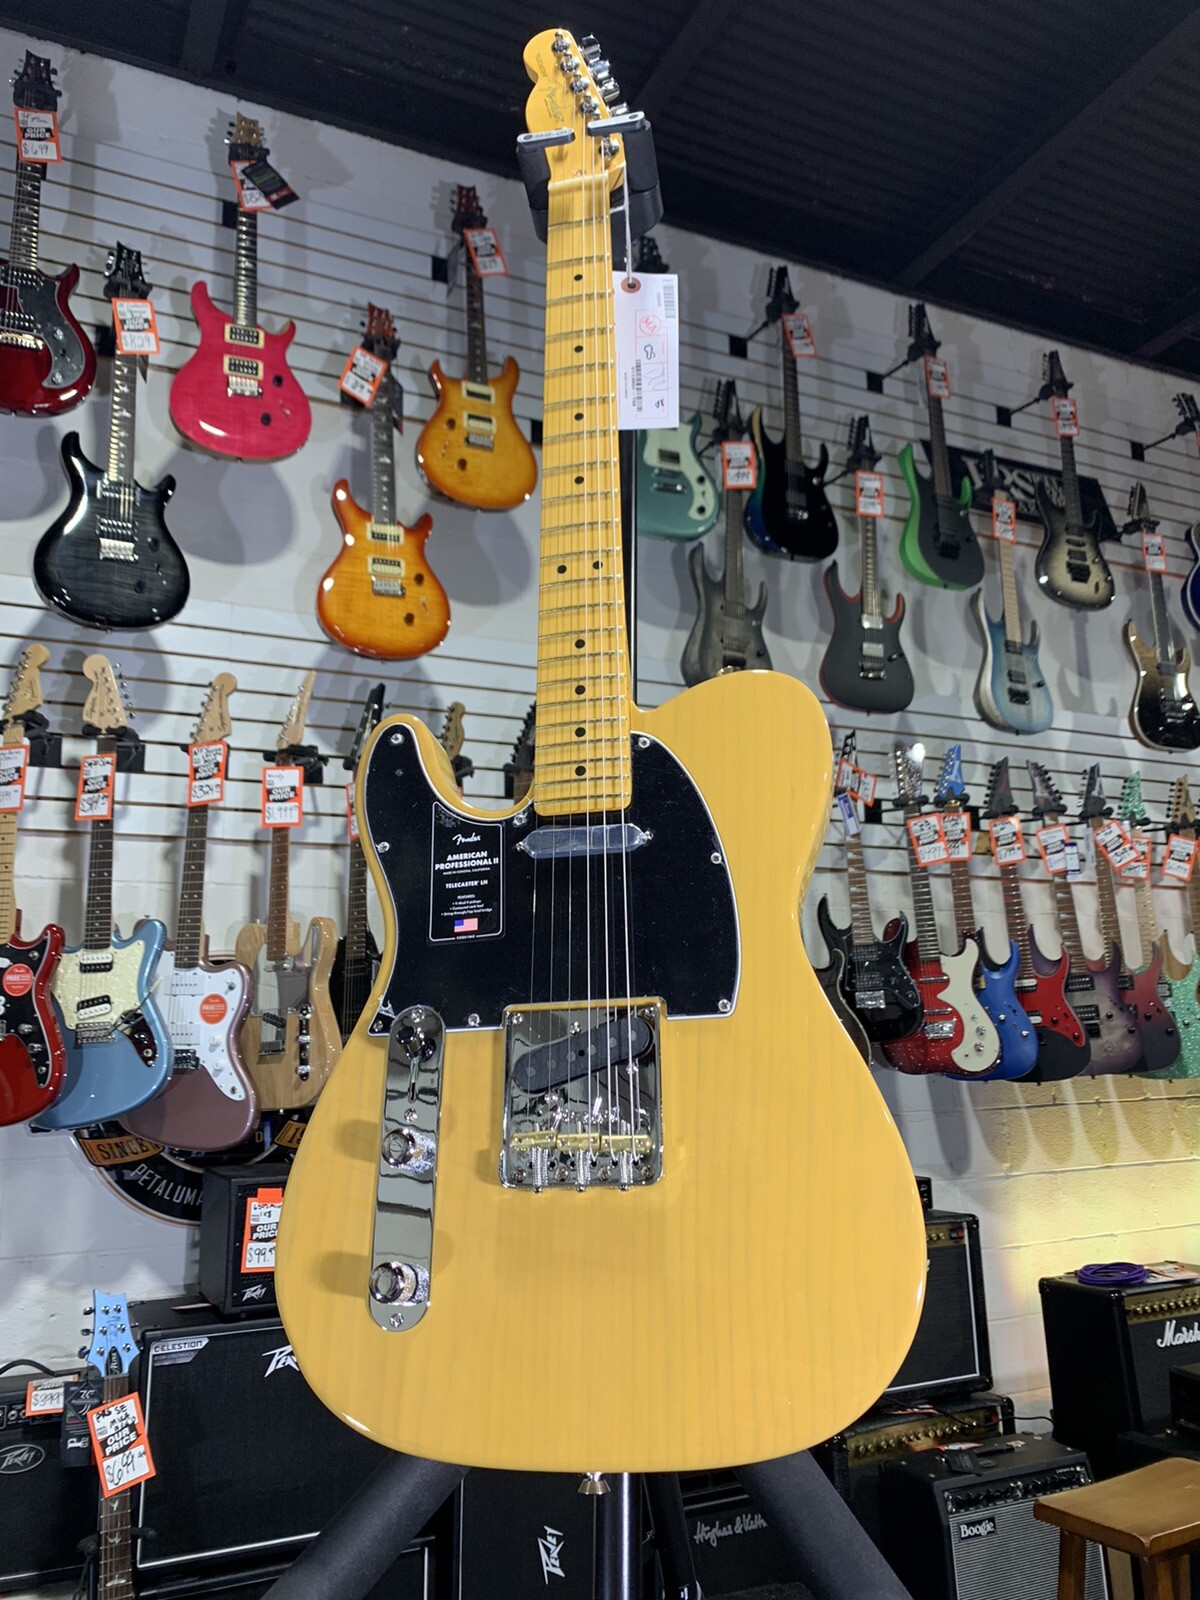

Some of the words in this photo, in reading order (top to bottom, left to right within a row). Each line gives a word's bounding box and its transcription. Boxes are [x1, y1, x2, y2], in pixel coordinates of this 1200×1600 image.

[452, 832, 481, 845] Fender
[435, 858, 493, 871] PROFESSIONAL
[446, 851, 488, 862] AMERICAN
[96, 1138, 149, 1160] SINCE
[256, 1223, 278, 1233] OUR
[153, 1341, 203, 1353] CELESTION
[114, 1404, 128, 1415] SE
[105, 1431, 138, 1456] PRICE
[106, 1426, 131, 1446] OUR
[693, 1520, 733, 1548] Hughes
[734, 1516, 743, 1534] &
[960, 1520, 995, 1539] Boogie
[537, 1525, 566, 1586] PEAVEY
